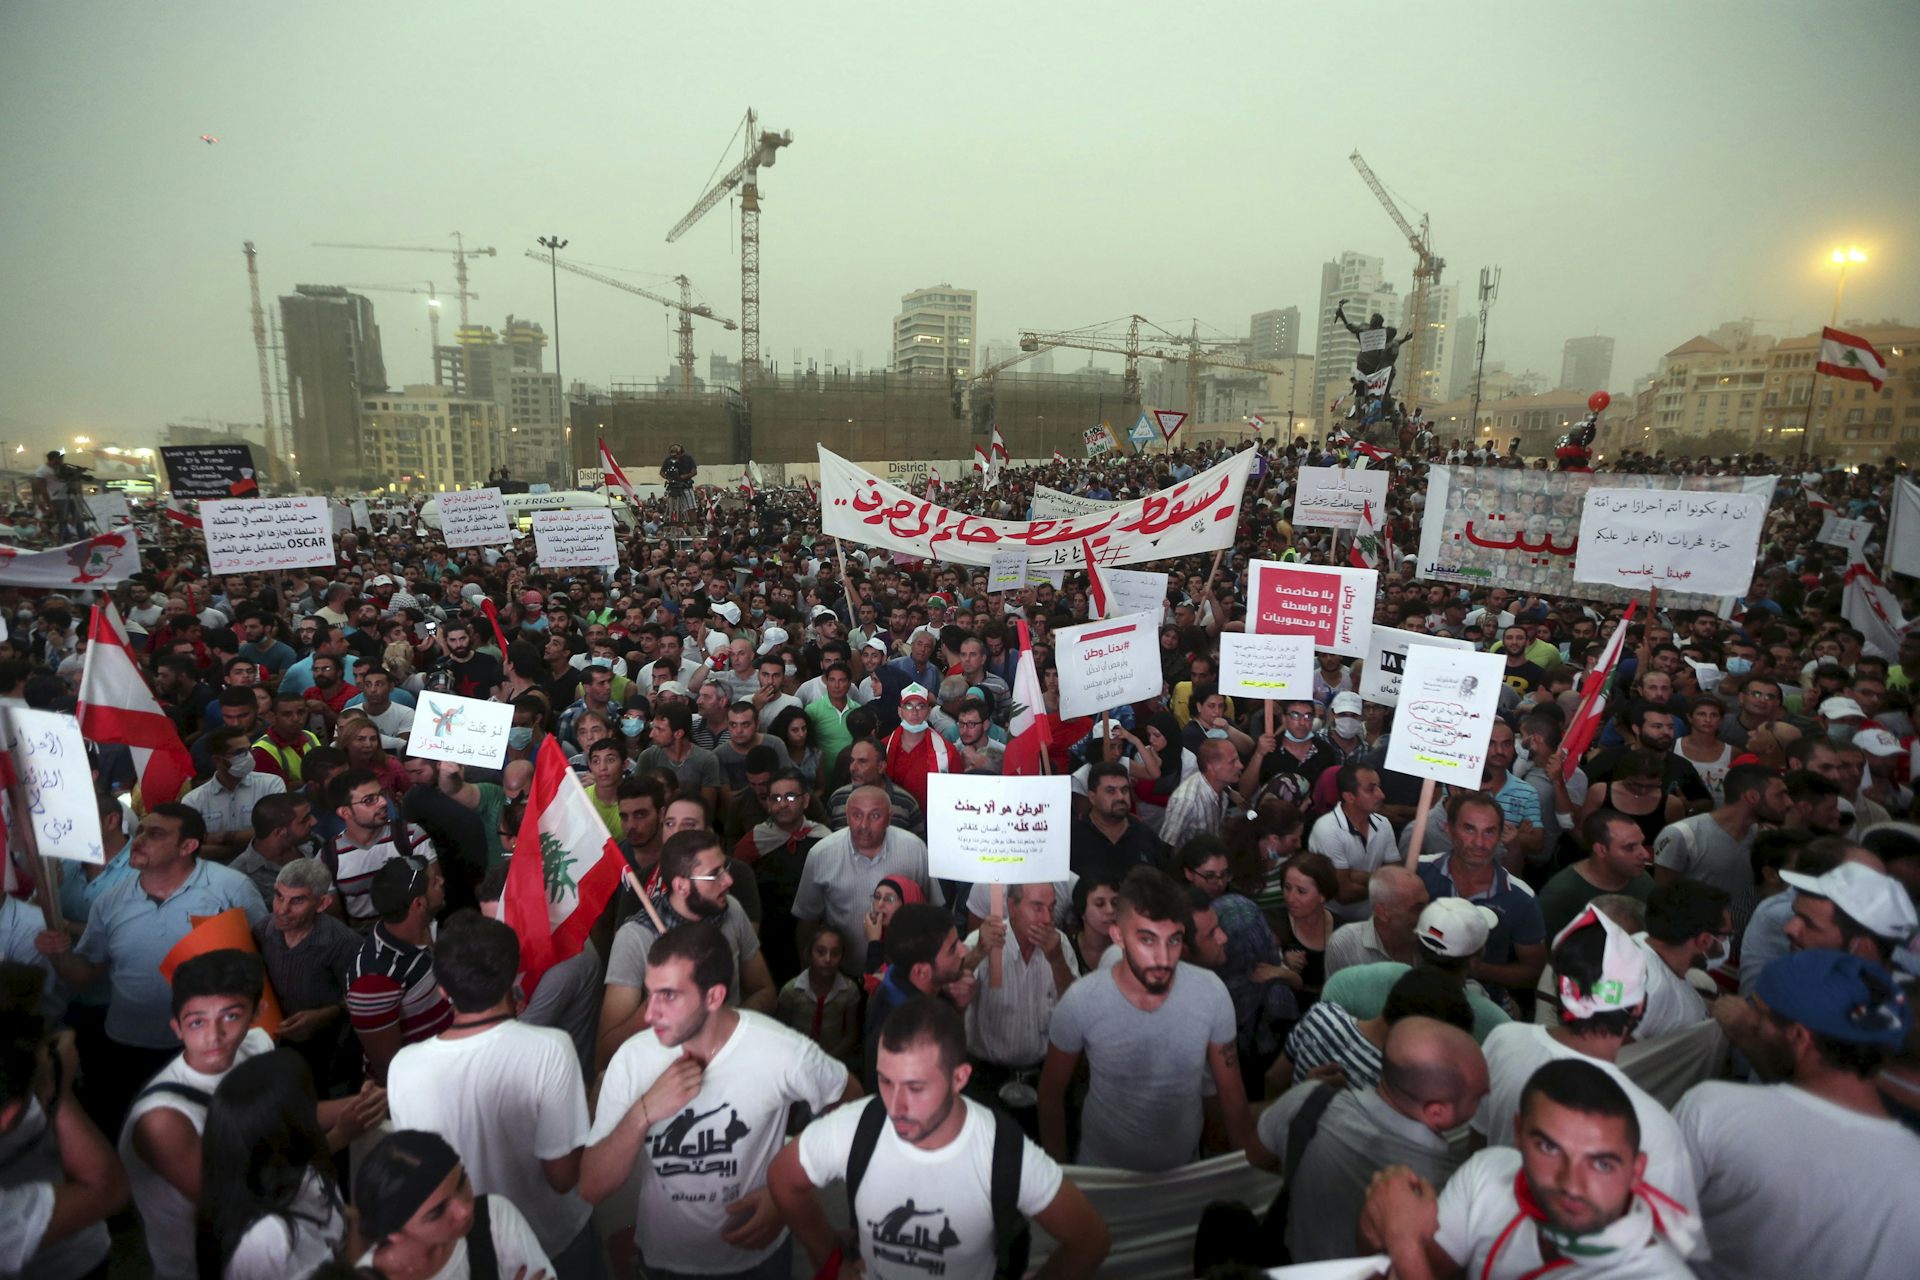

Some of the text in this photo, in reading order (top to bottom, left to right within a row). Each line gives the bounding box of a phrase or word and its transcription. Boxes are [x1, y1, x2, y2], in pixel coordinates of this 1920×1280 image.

[889, 462, 928, 472] District
[580, 470, 605, 481] Distric
[1349, 480, 1372, 495] بدنا
[268, 501, 292, 512] لقانون
[526, 496, 564, 505] FRISCO
[1121, 475, 1235, 535] يسقط
[1612, 499, 1628, 512] من
[1664, 498, 1682, 518] أنتم
[1687, 499, 1718, 518] تكونوا
[1721, 500, 1729, 518] لم
[212, 514, 318, 527] حسن تمثيل الشعب في السلطة
[239, 530, 266, 540] الوحيد
[1010, 512, 1121, 547] يسقط
[1594, 528, 1618, 544] عليكم
[287, 537, 326, 549] OSCAR
[1624, 532, 1639, 544] عار
[254, 542, 286, 552] بالتمثيل
[1276, 585, 1334, 602] بلا محاصصة
[1282, 600, 1332, 616] بلا واسطة
[1262, 612, 1330, 631] بلا محسوبيات
[1339, 586, 1357, 644] #بدنا_وطن
[1084, 640, 1130, 660] #بدنا_وطن
[1084, 680, 1102, 690] مجلس
[955, 800, 981, 815] يحدث
[1000, 804, 1012, 816] هو
[957, 823, 978, 833] كنفاني
[981, 823, 1000, 834] غسان
[1032, 820, 1048, 831] ذلك
